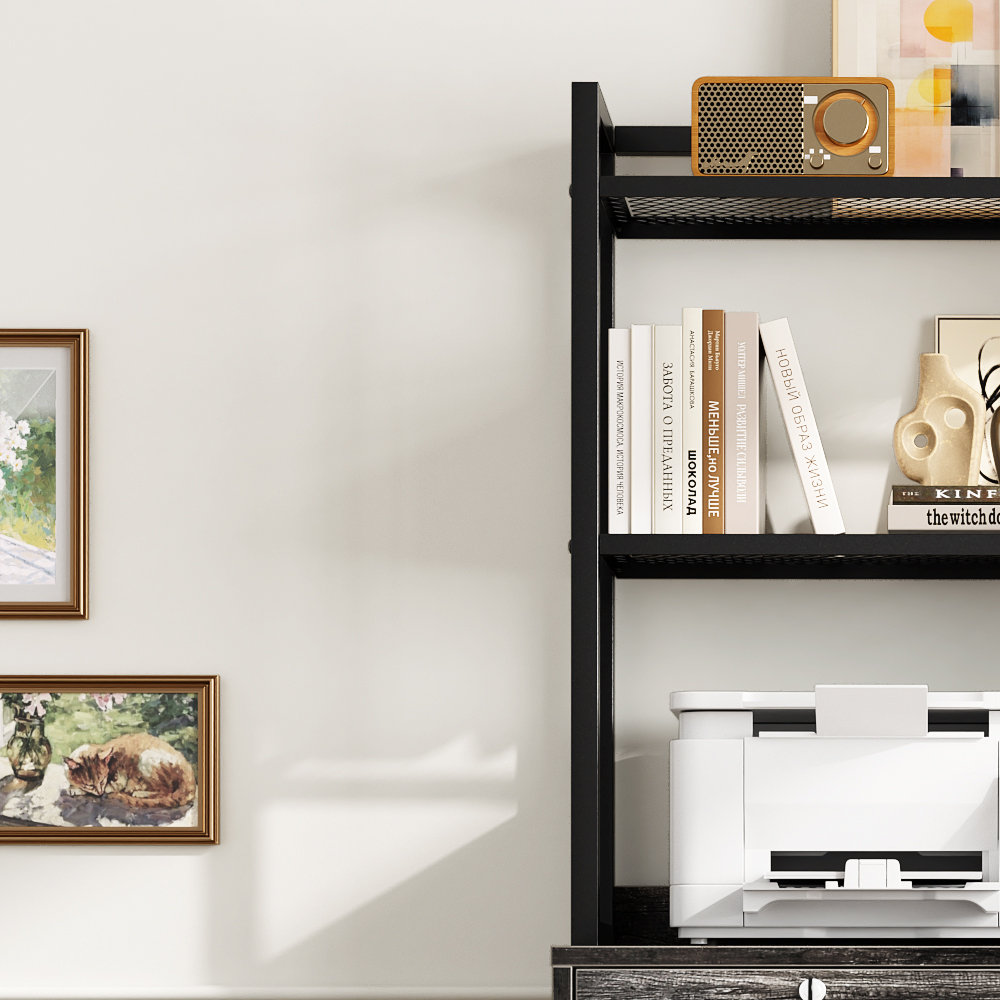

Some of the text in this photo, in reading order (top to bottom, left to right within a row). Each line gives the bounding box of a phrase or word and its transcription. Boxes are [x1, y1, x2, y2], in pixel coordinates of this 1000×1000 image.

[616, 360, 624, 391] ИСТОРИЯ
[661, 362, 674, 512] ЗАБОТА О ПРЕДАННЫХ
[775, 348, 829, 509] НОВЫЙ ОБРАЗ ЖИЗНИ
[616, 449, 624, 480] ИСТОРИЯ
[686, 450, 697, 516] ШОКОЛАД
[616, 481, 624, 516] ЧЕЛОВЕКА
[707, 474, 720, 518] ЛУЧШЕ
[926, 508, 949, 526] the
[950, 508, 987, 526] witch
